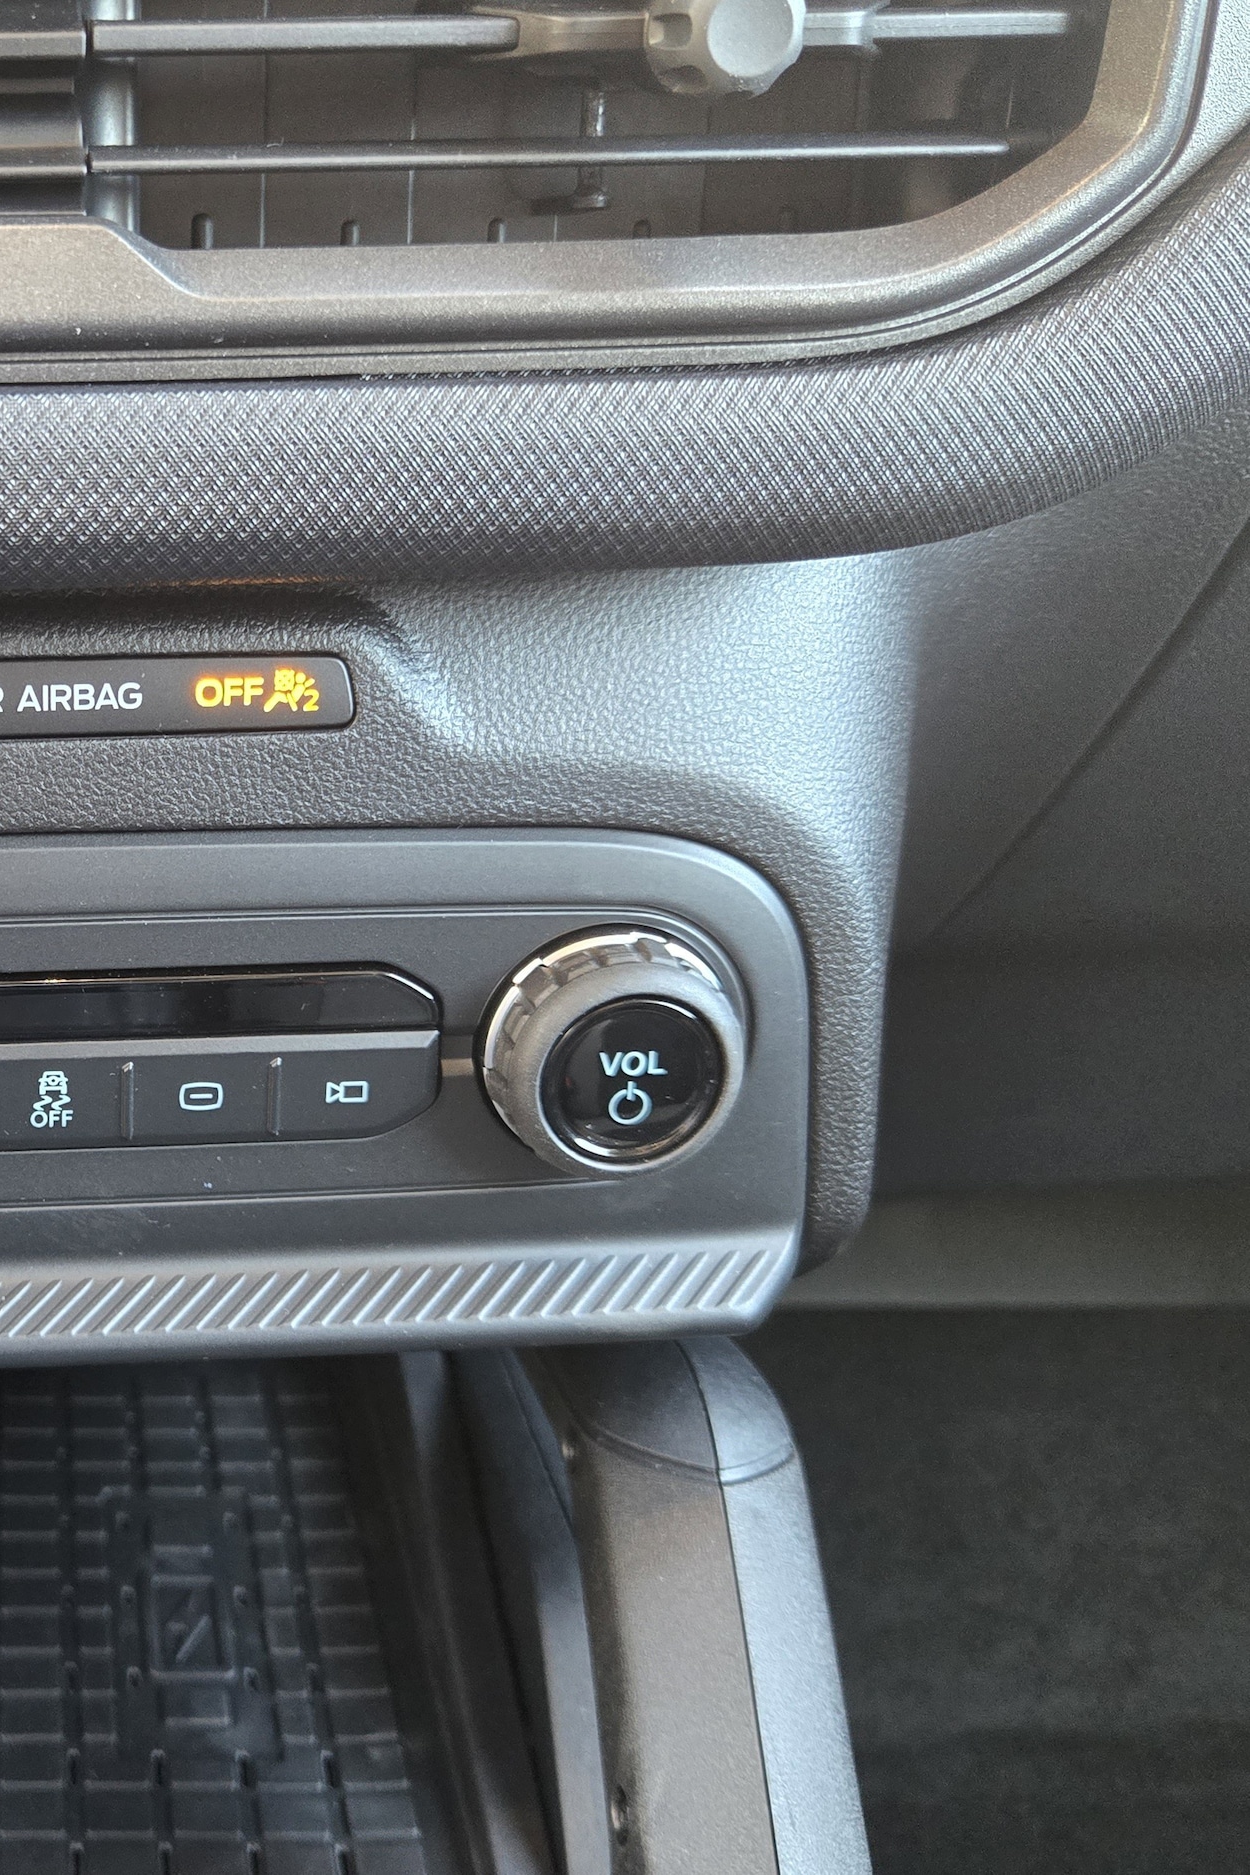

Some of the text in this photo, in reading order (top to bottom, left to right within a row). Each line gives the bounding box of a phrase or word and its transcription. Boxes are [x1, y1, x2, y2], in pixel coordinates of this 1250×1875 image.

[17, 682, 143, 712] AIRBAG
[194, 676, 265, 708] OFF
[599, 1050, 668, 1077] VOL
[29, 1110, 74, 1128] OFF
